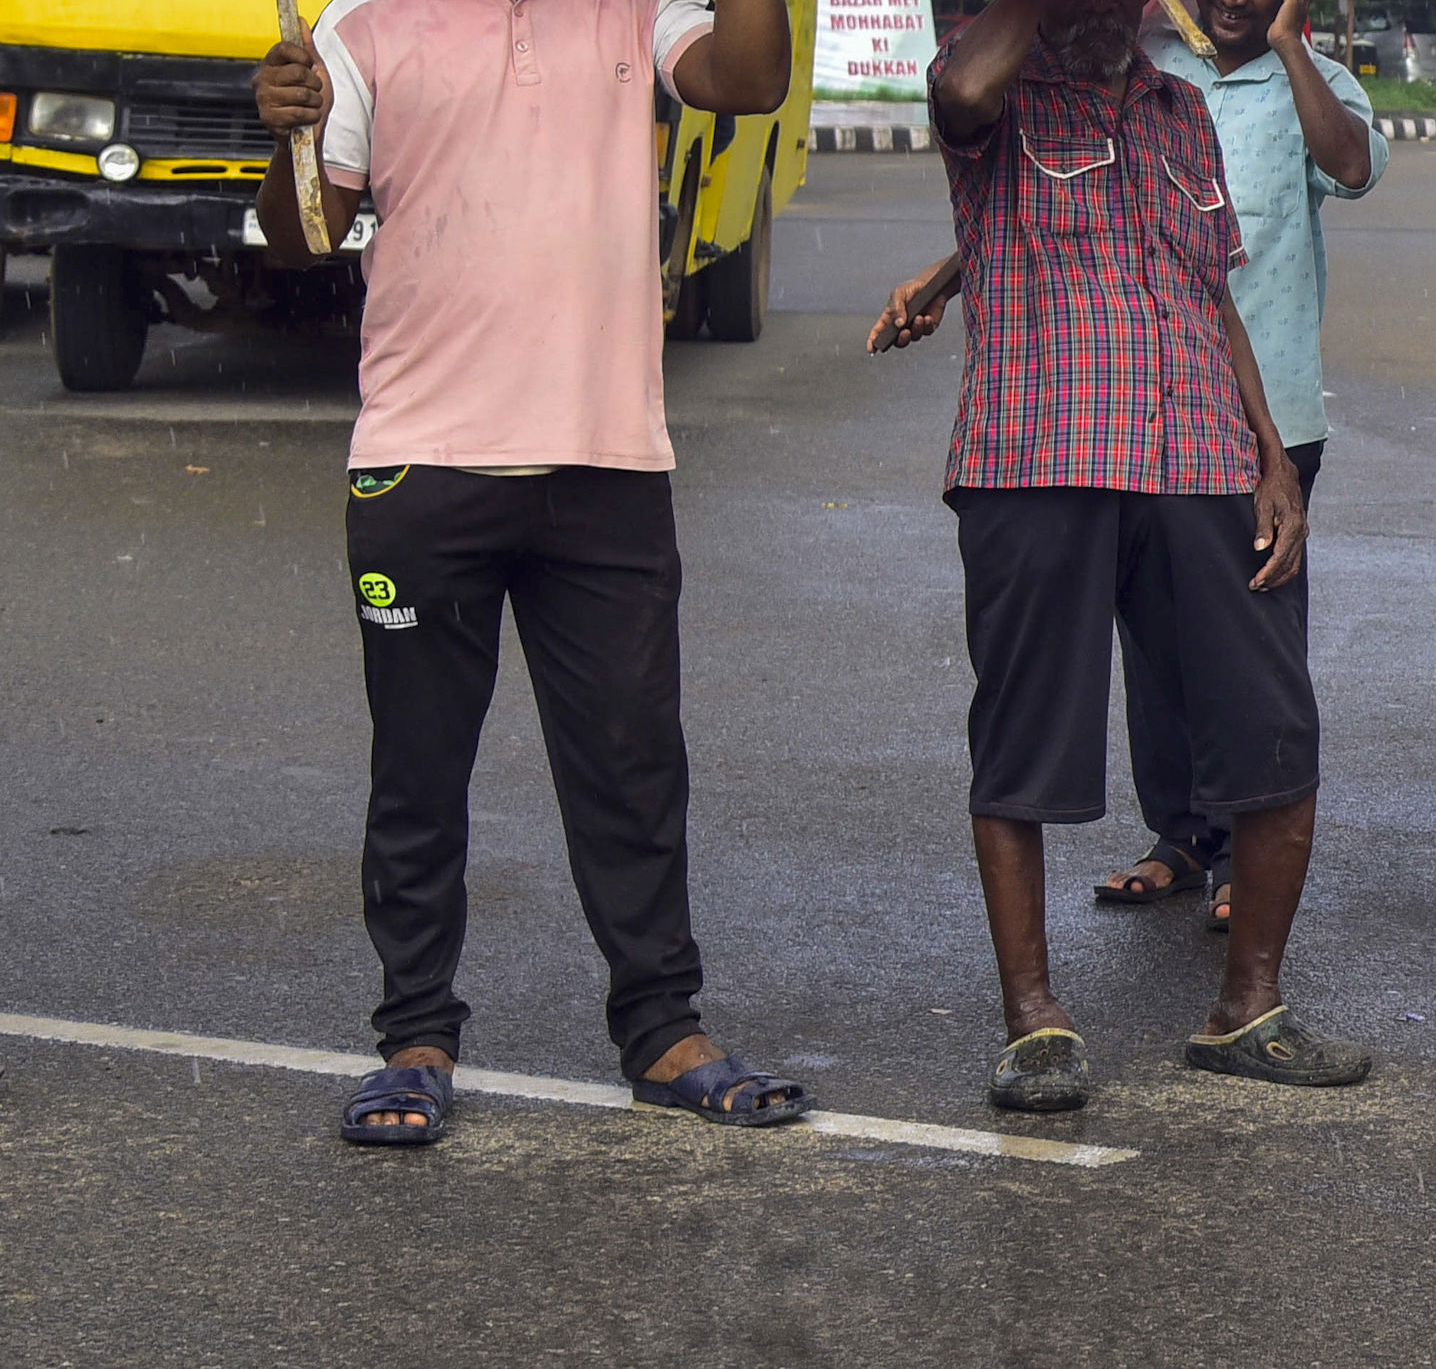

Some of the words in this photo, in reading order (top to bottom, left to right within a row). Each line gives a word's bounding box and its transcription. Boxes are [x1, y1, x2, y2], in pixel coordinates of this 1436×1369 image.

[830, 14, 924, 30] MOHHABAT
[872, 37, 889, 52] KI
[848, 60, 917, 76] DUKKAN
[362, 581, 390, 600] 23
[360, 604, 417, 624] JORDAN
